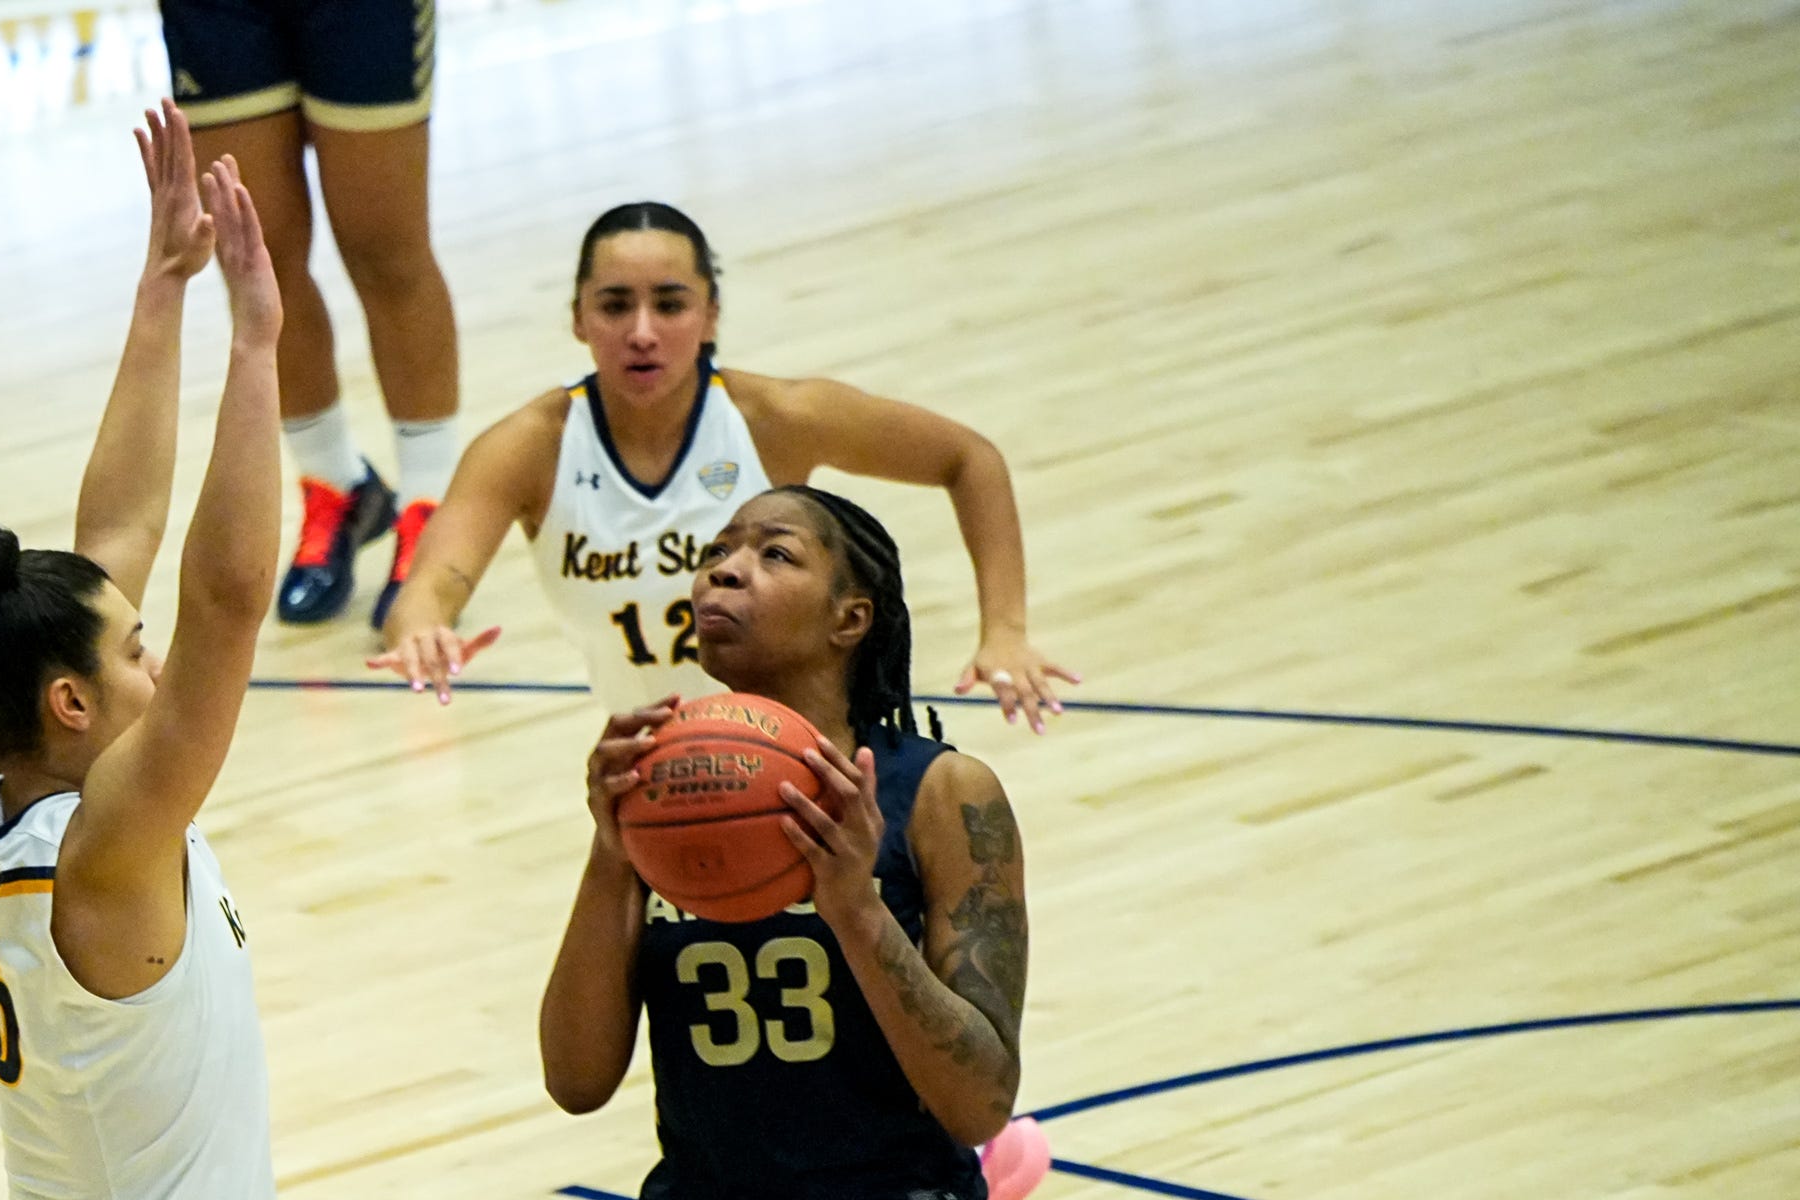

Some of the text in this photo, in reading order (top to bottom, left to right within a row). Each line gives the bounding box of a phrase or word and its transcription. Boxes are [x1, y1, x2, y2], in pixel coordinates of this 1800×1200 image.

[561, 531, 642, 581] Kent
[610, 597, 700, 667] 12
[675, 936, 836, 1067] 33
